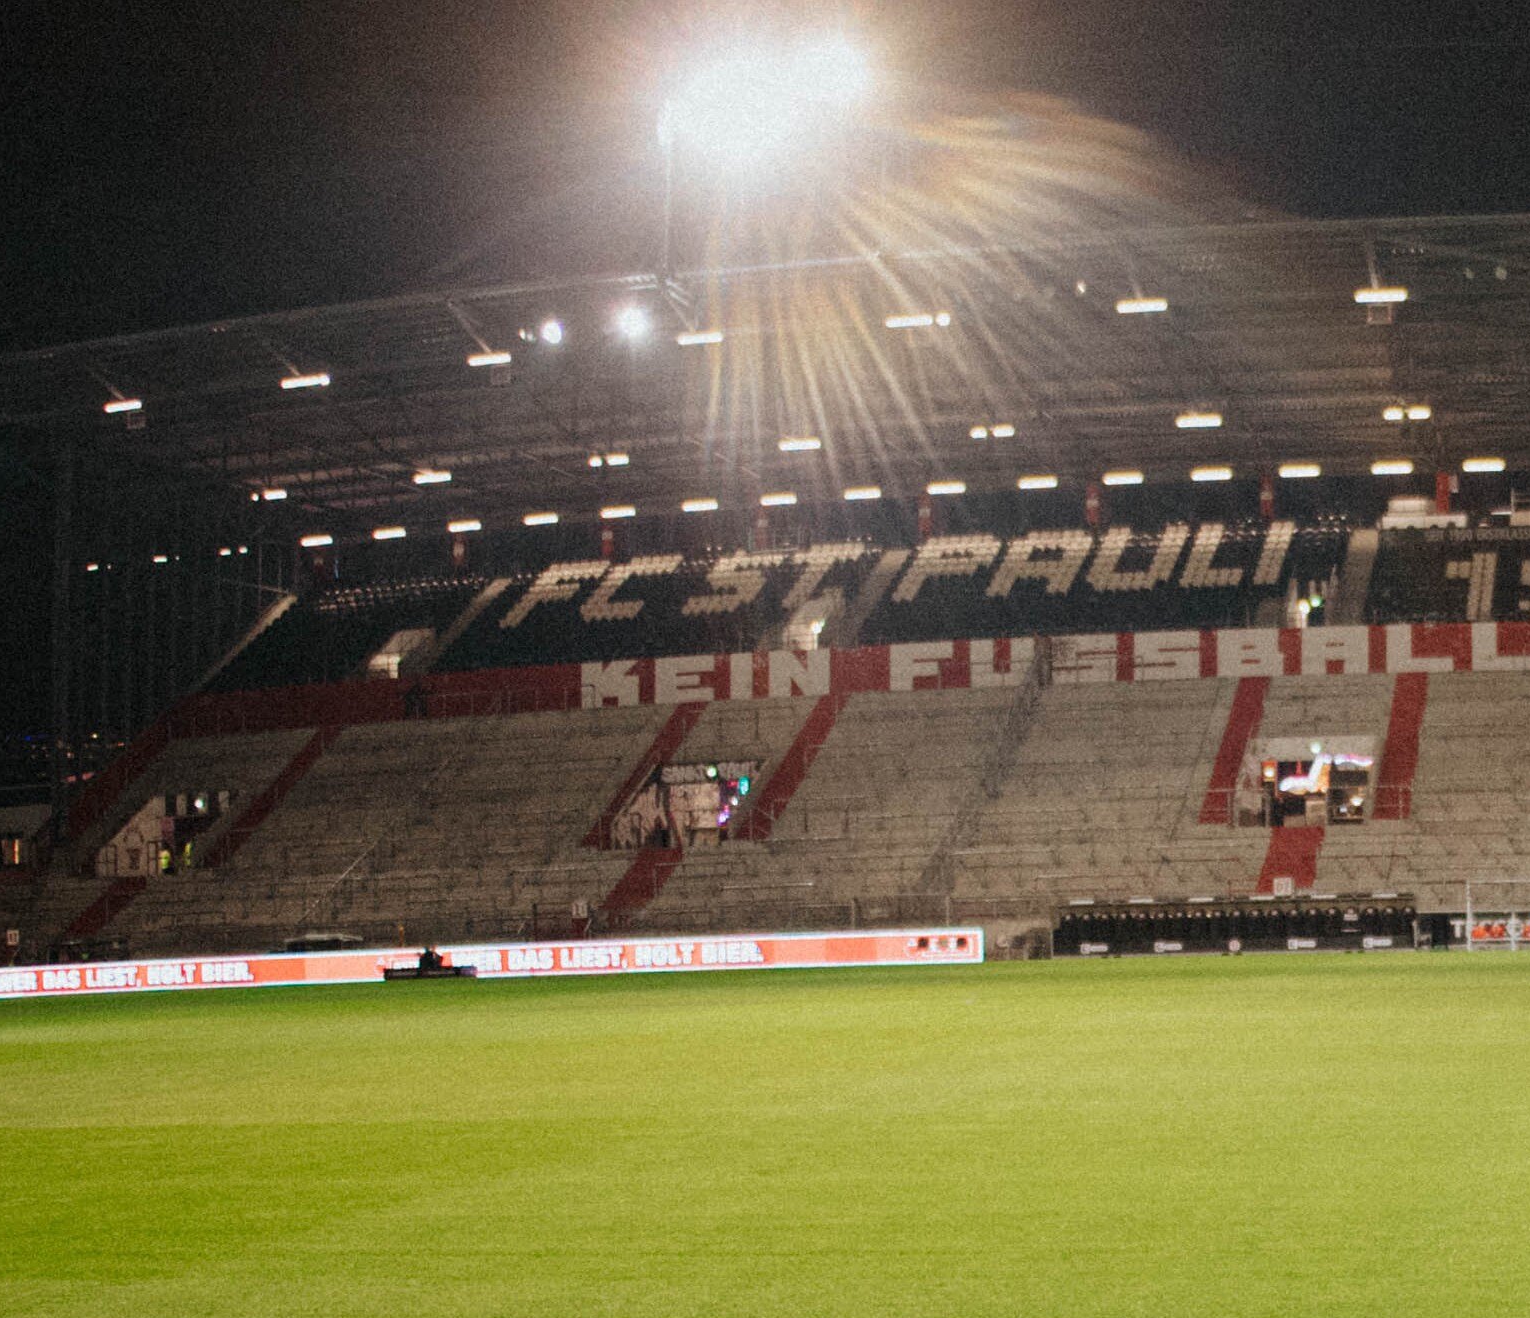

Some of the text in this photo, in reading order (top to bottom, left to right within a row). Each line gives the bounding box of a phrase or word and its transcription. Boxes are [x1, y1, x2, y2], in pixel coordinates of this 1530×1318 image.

[499, 552, 684, 631] FC
[891, 521, 1298, 604] PAULI
[581, 647, 831, 710] KEIN
[43, 969, 81, 990] DAS
[85, 966, 143, 989] LIEST,
[146, 963, 197, 985] HOLT
[201, 961, 254, 983] BIER.
